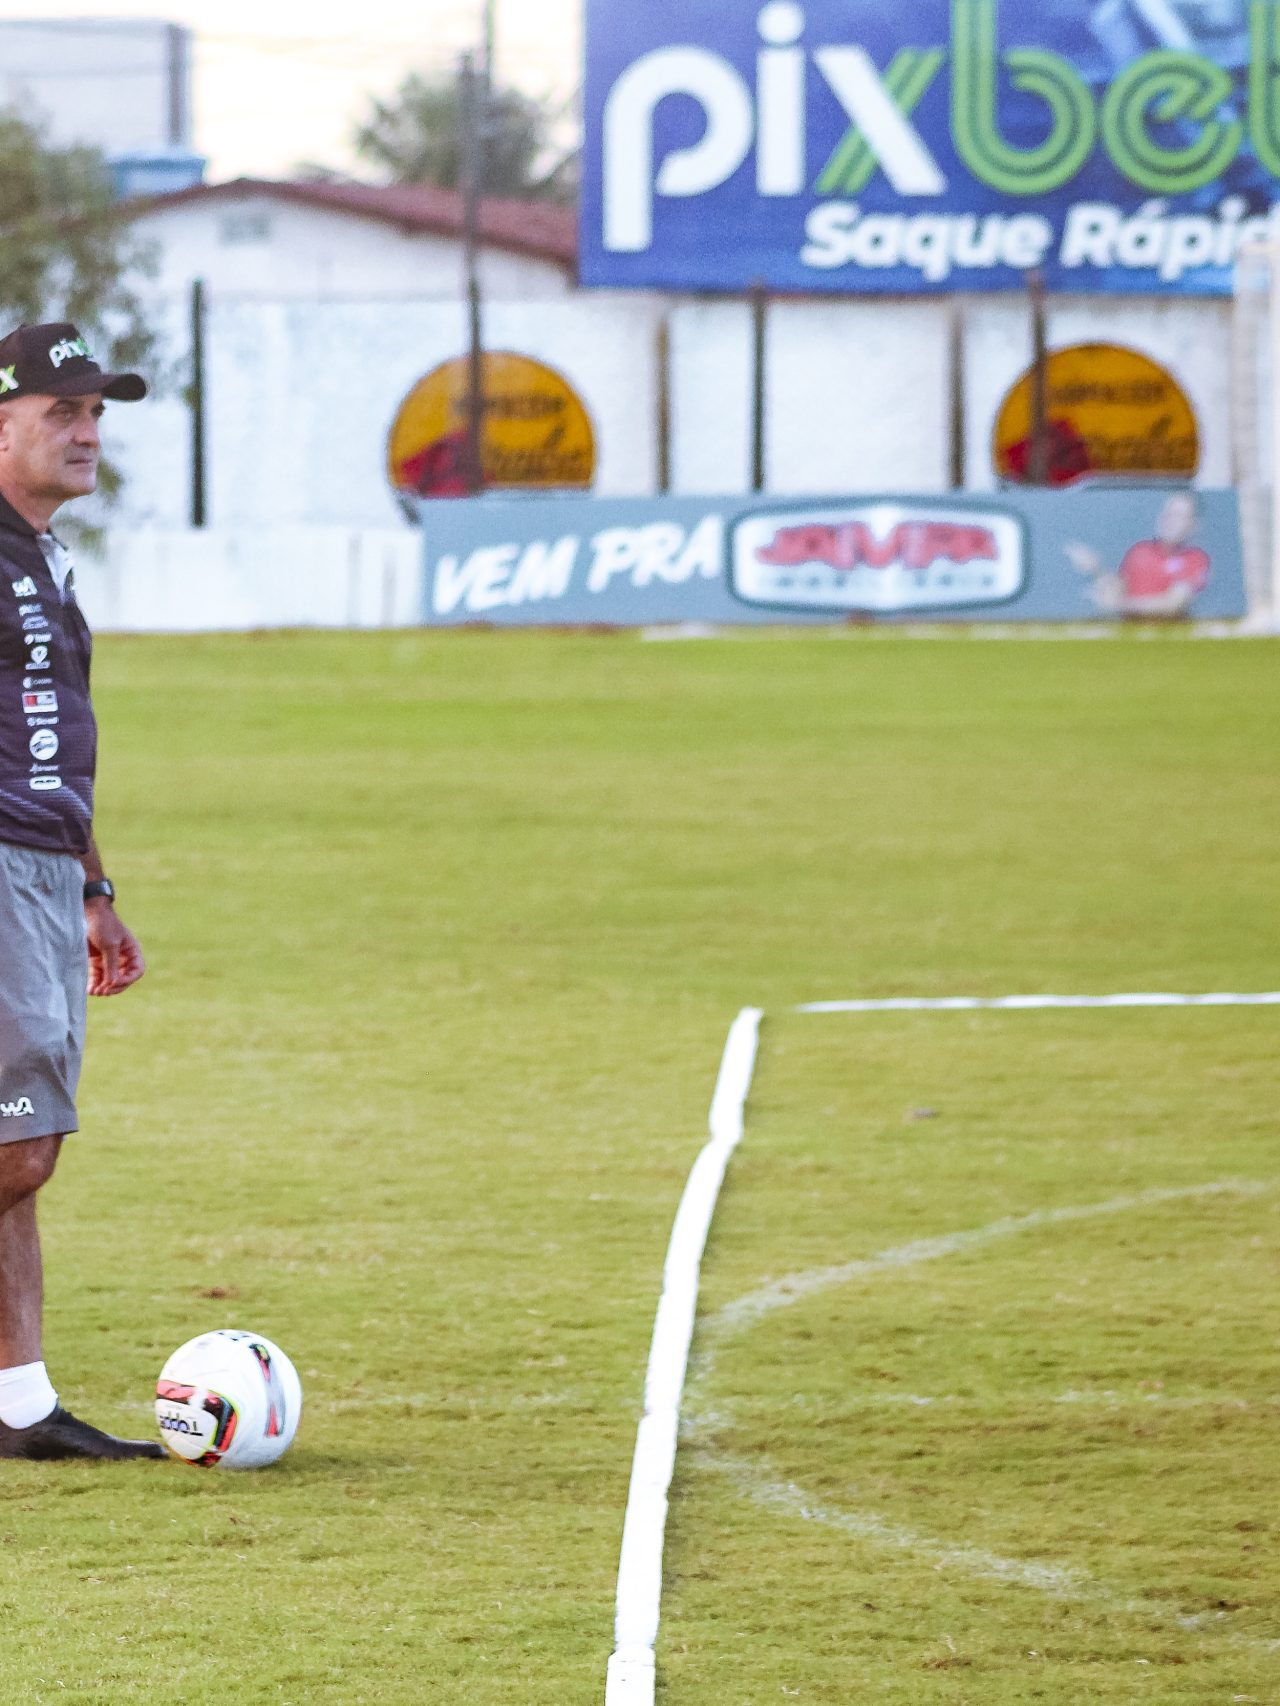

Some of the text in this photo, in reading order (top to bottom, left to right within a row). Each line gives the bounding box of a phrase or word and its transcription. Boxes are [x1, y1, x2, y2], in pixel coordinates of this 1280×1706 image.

[800, 200, 1053, 282] Saque
[432, 514, 724, 616] VEM PRA
